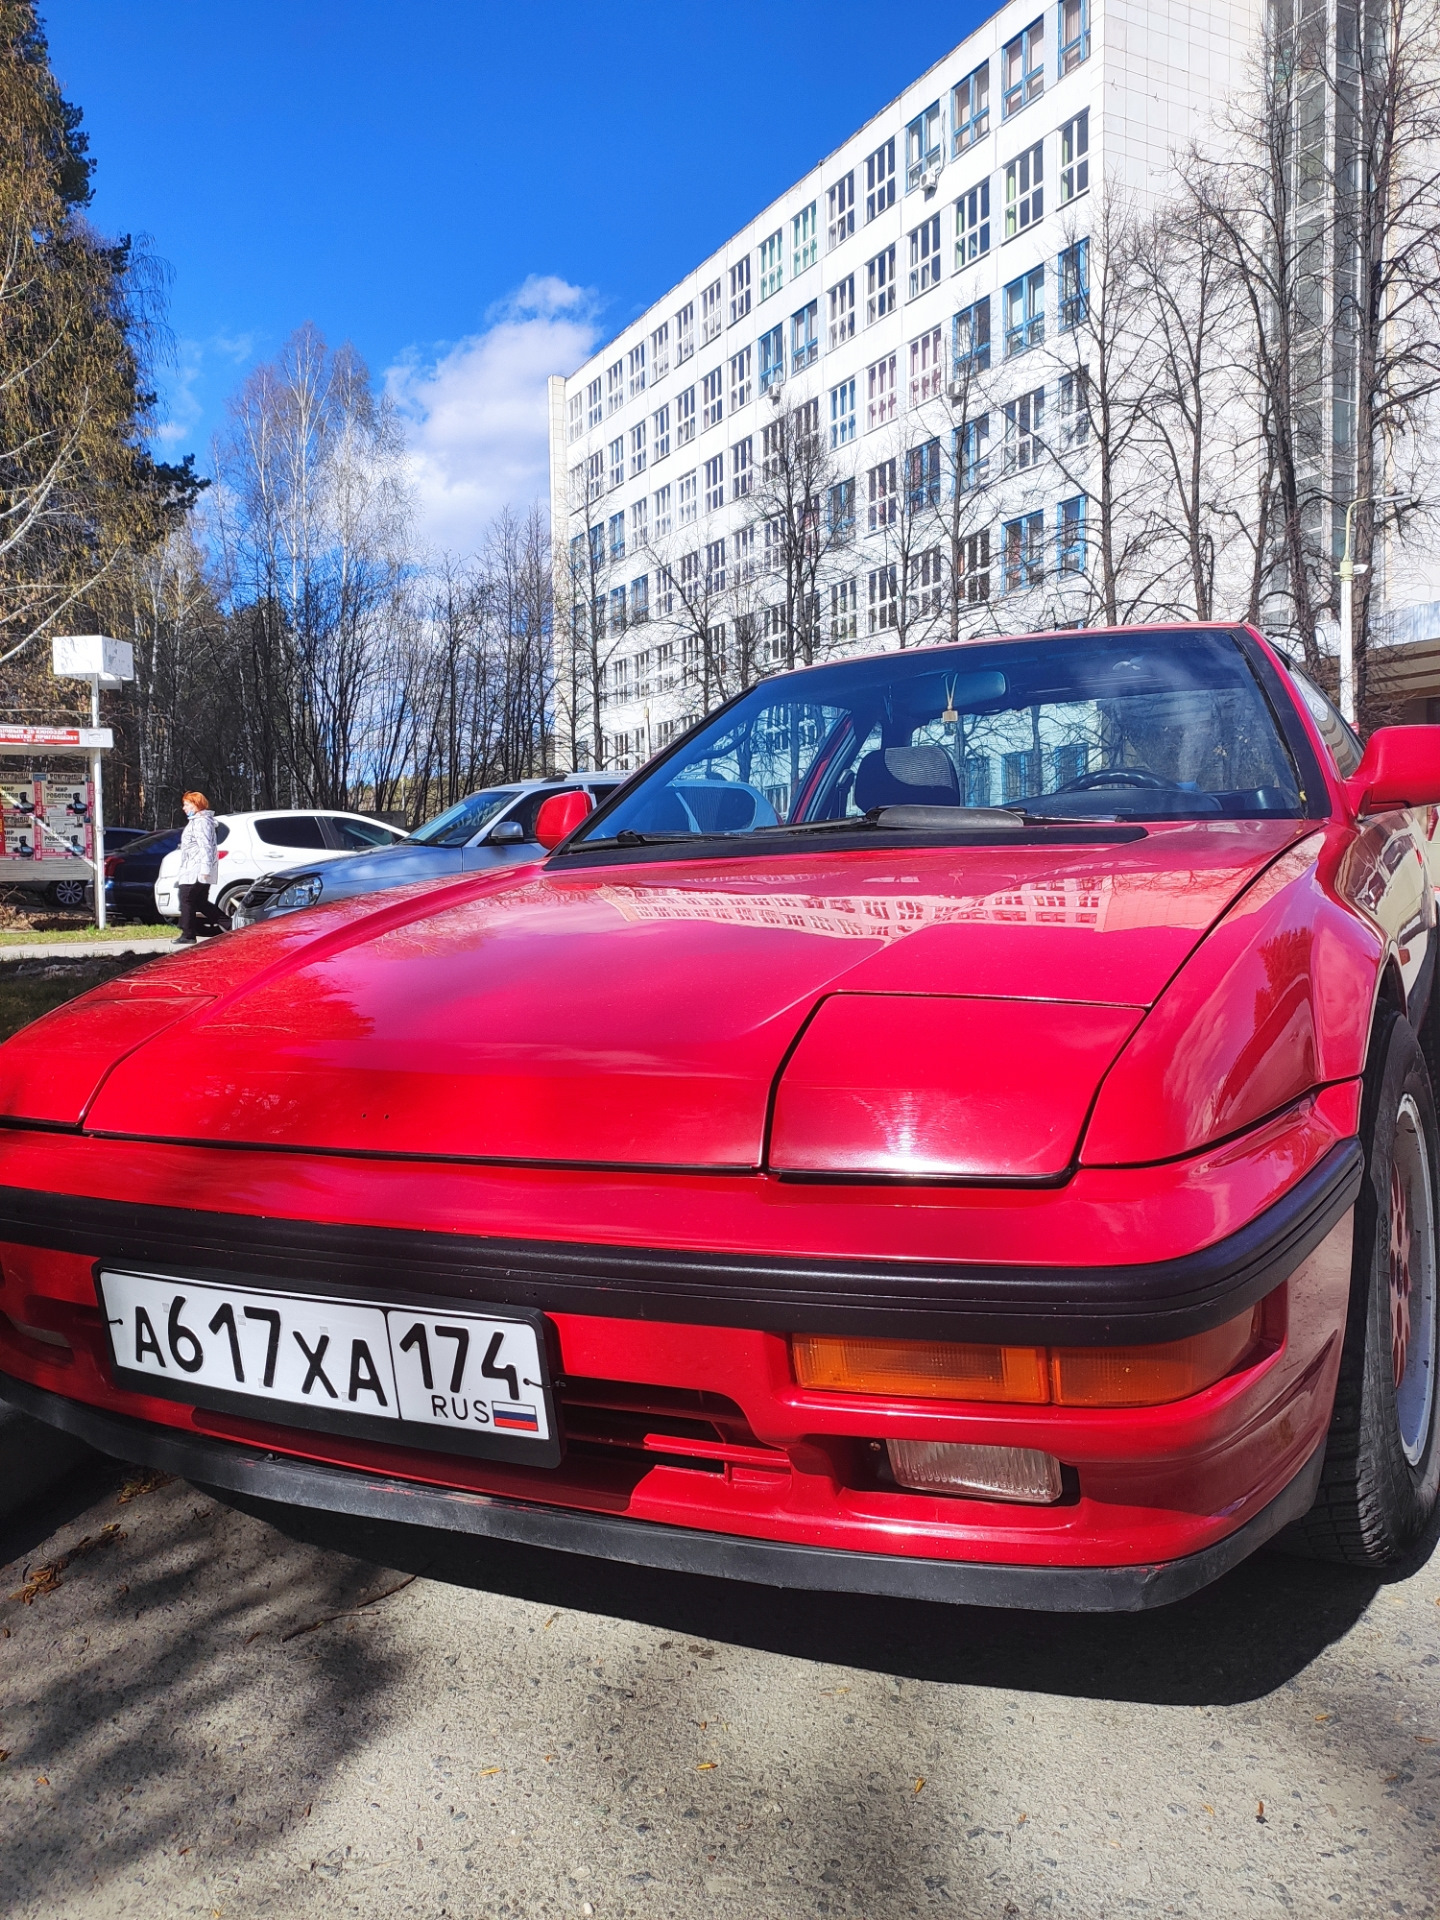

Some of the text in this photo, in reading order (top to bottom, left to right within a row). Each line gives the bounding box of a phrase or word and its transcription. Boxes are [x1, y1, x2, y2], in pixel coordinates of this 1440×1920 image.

[134, 1295, 520, 1407] А617ХА 174
[432, 1394, 490, 1424] RUS
